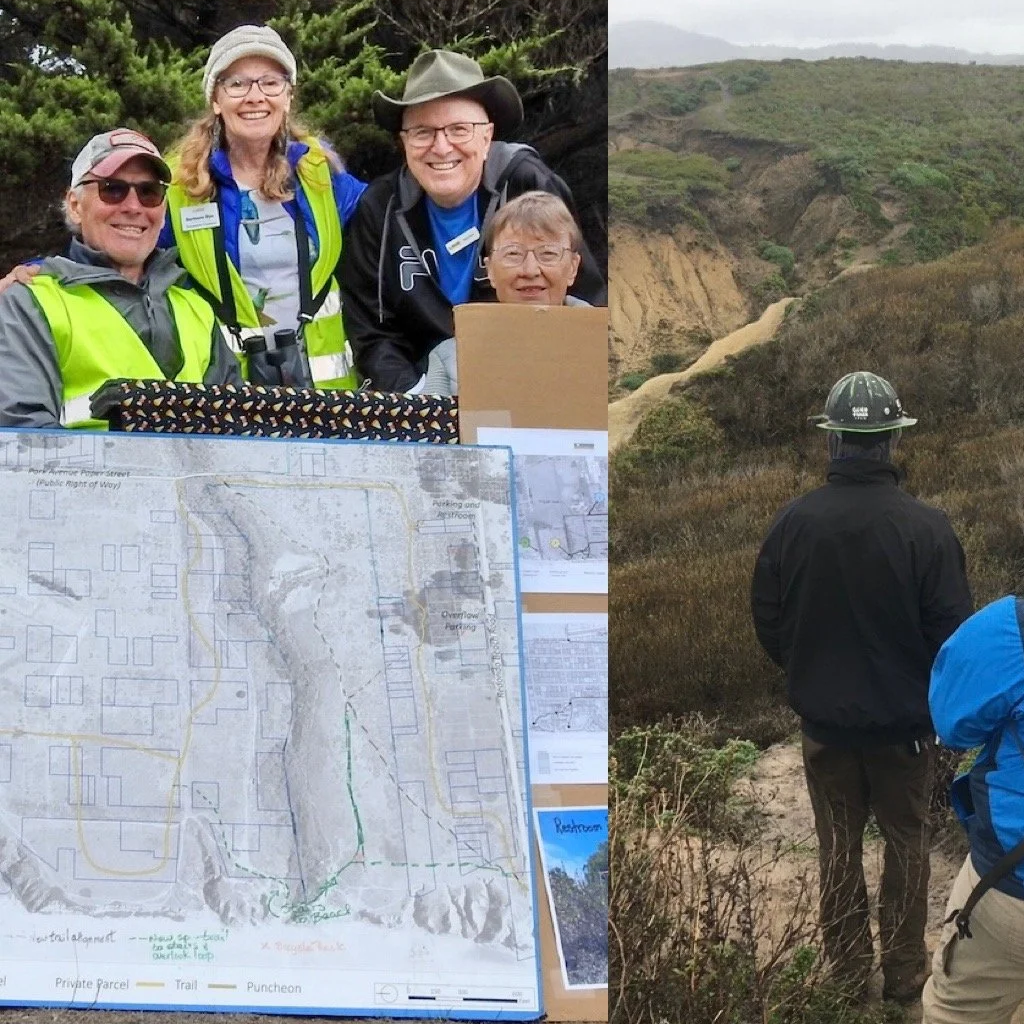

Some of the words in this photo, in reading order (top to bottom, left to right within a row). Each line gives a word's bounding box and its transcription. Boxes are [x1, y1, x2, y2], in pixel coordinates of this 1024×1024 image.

[37, 479, 62, 487] (Public
[65, 480, 86, 488] Right
[100, 481, 121, 490] Way)
[433, 500, 463, 509] Parking
[464, 501, 481, 509] and
[441, 611, 479, 620] Overflow
[445, 623, 476, 632] Parking
[554, 817, 602, 834] Restroom
[55, 978, 93, 989] Private
[97, 979, 129, 990] Parcel
[176, 979, 198, 991] Trail
[247, 981, 302, 994] Puncheon
